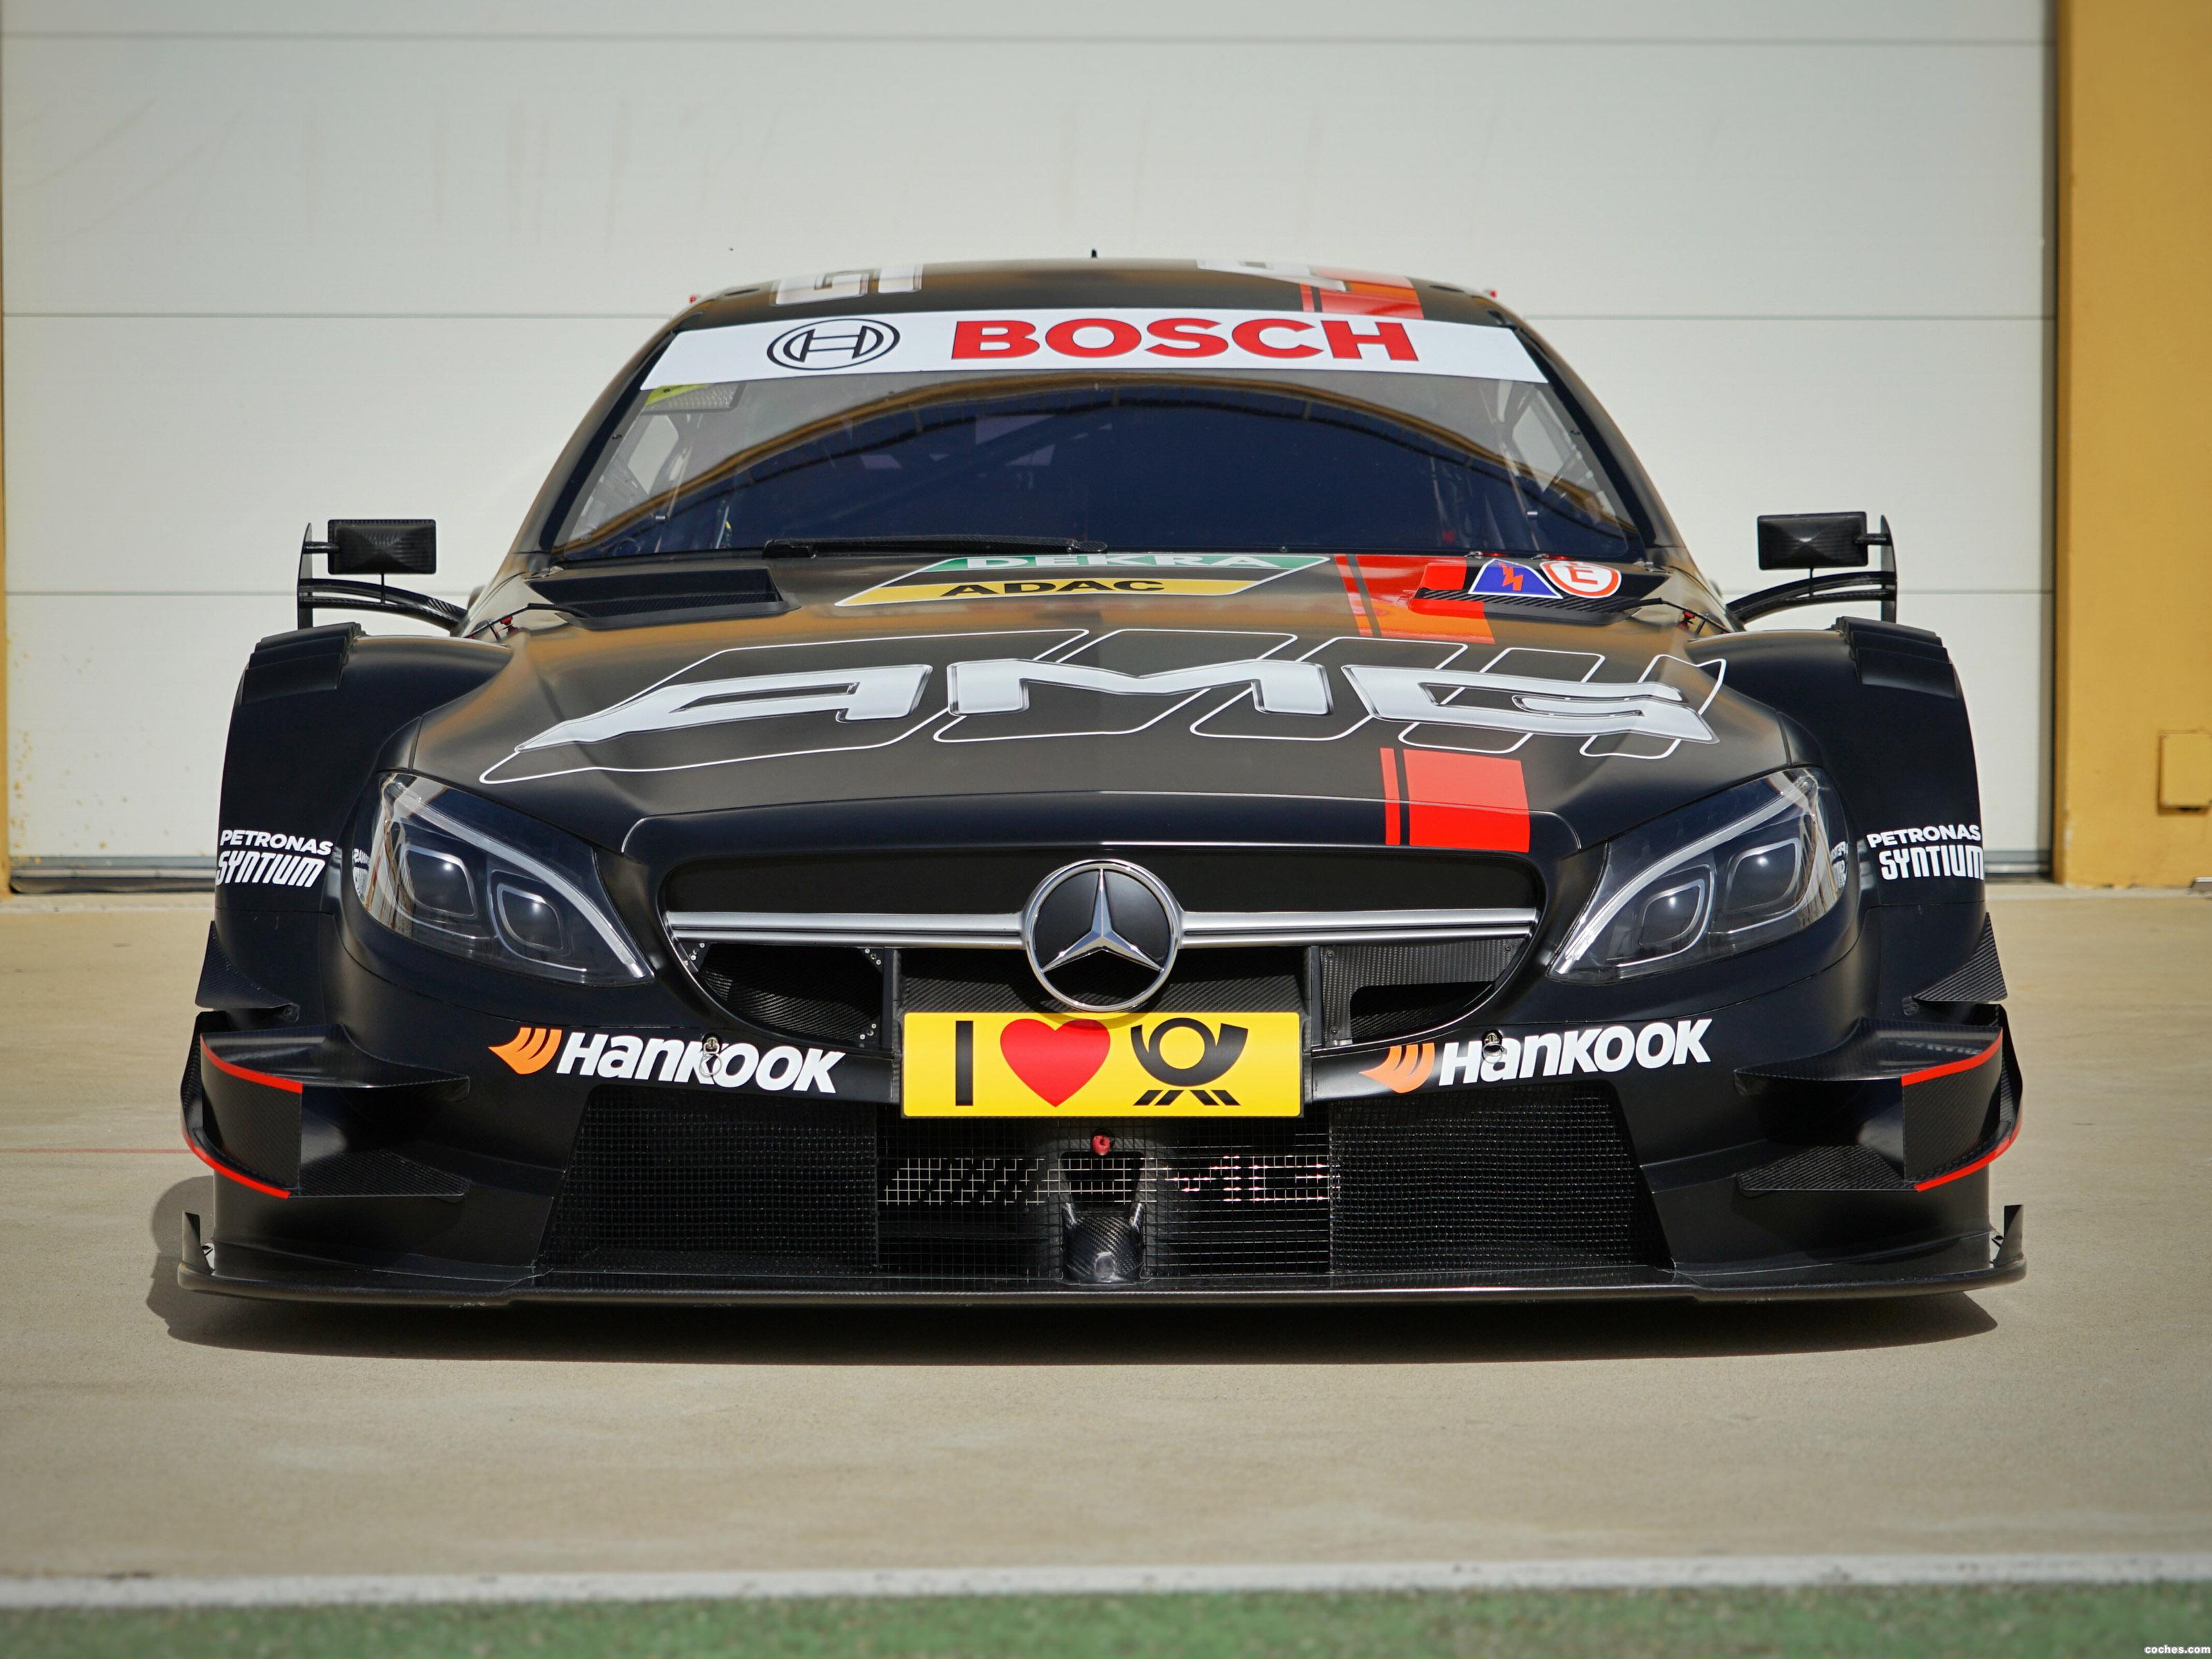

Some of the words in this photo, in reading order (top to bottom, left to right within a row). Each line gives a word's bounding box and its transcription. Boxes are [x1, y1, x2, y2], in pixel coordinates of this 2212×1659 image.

[951, 318, 1419, 362] BOSCH
[968, 555, 1280, 569] DEKRA
[939, 580, 1165, 597] ADAC
[514, 657, 1721, 753] AMG
[220, 830, 333, 856] PETRONAS
[1866, 824, 1982, 848] PETRONAS
[216, 850, 326, 888] SYNTIUM
[1879, 845, 1984, 881] SYNTIUM
[955, 1020, 973, 1106] I
